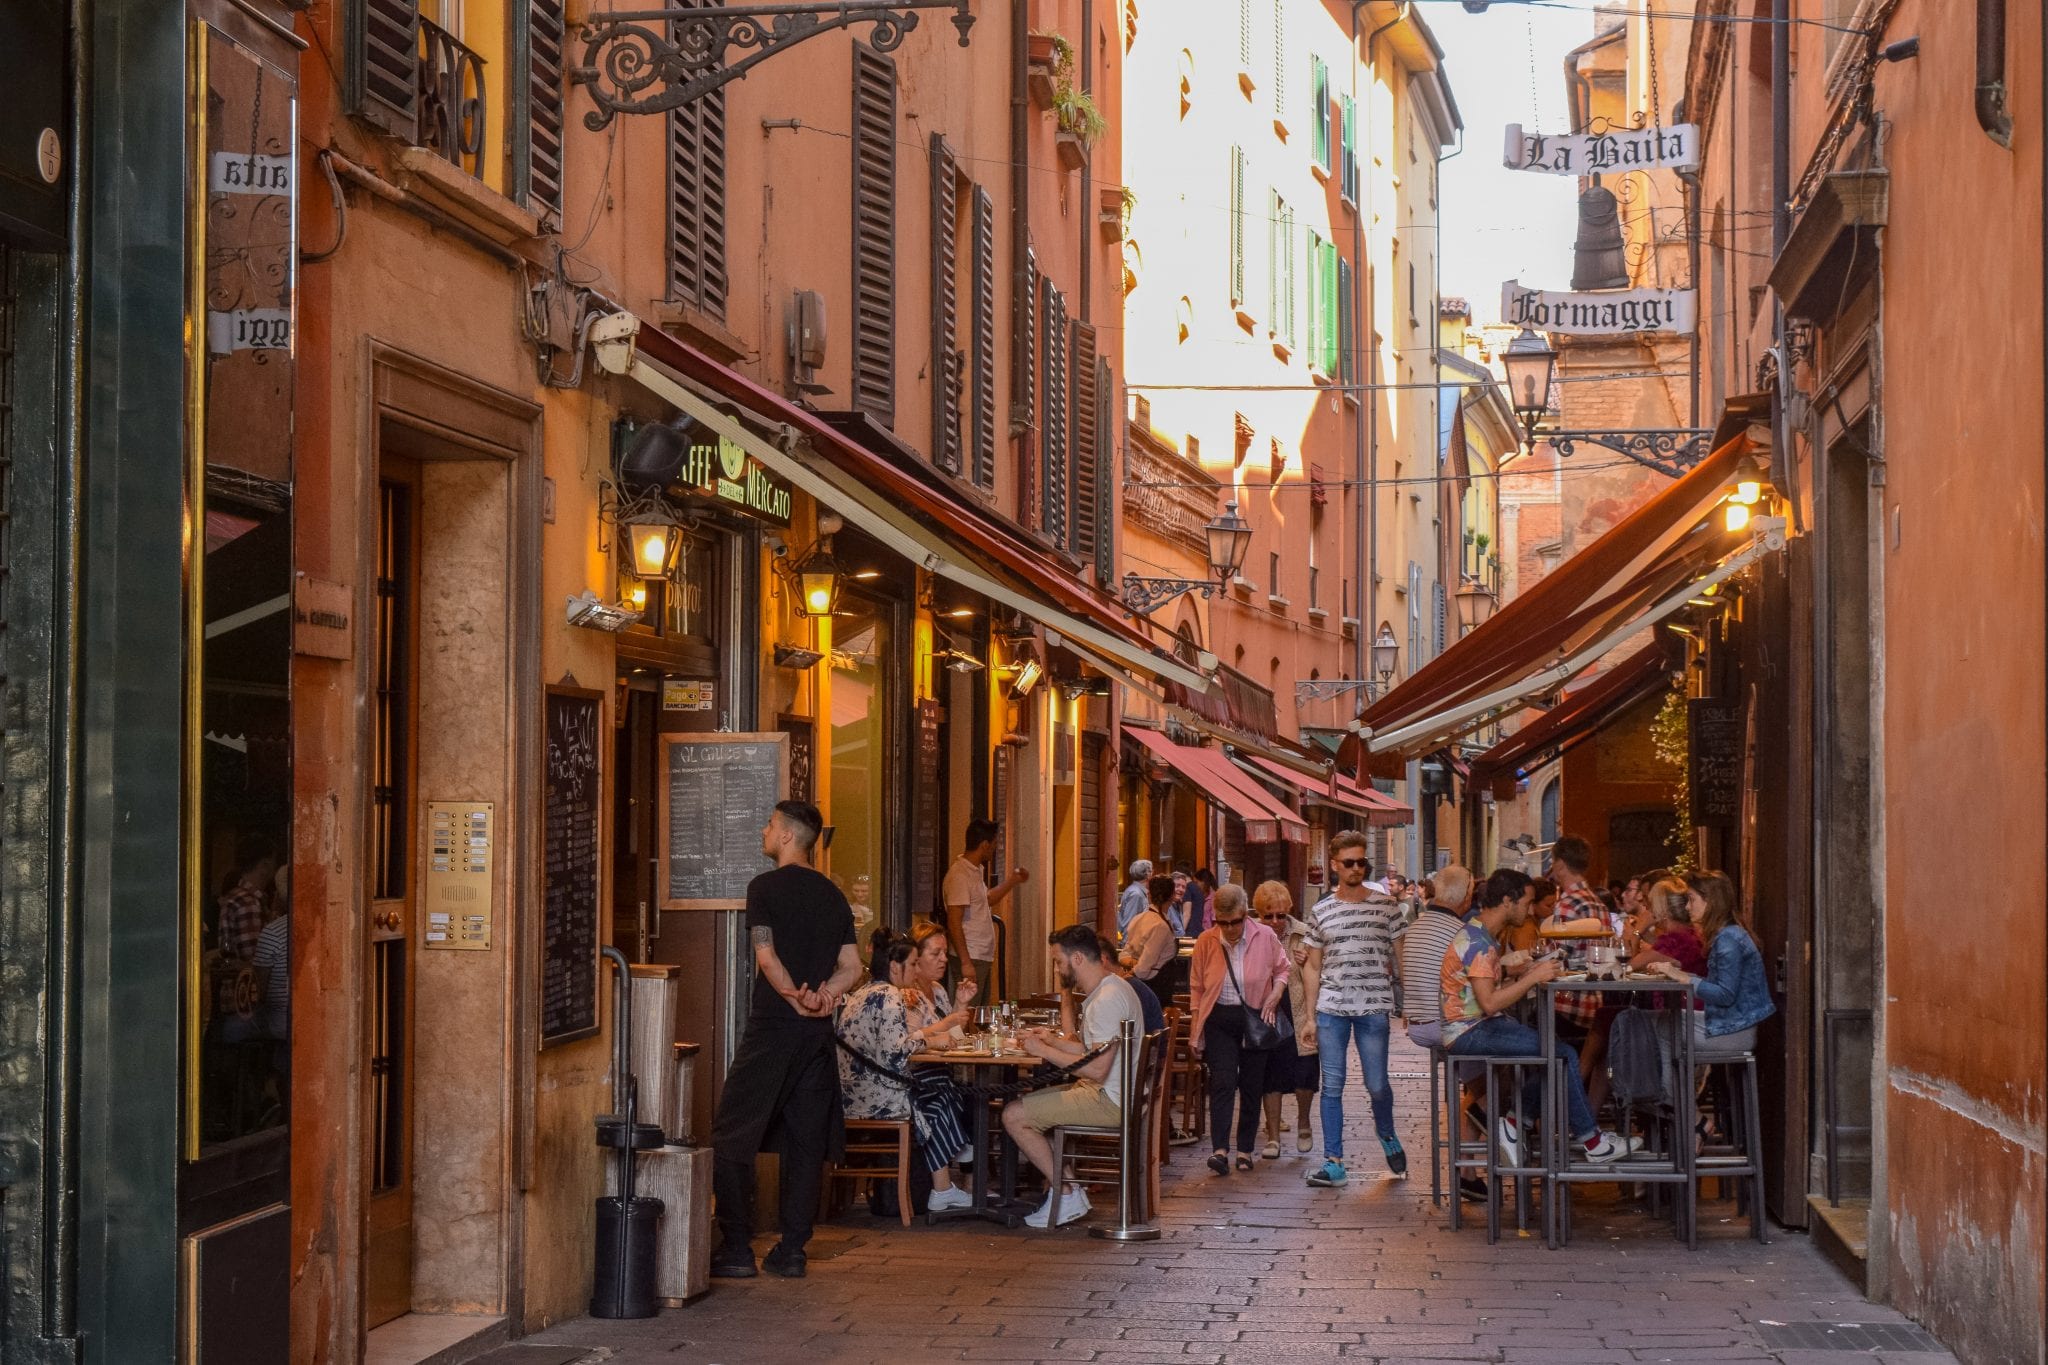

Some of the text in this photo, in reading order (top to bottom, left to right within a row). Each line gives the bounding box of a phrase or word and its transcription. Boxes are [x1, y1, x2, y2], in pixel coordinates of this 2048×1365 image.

[1523, 129, 1685, 175] La Baita
[1511, 289, 1675, 331] Formaggi
[676, 445, 718, 491] FFE'
[746, 459, 790, 520] MERCATO
[665, 690, 687, 702] Pago
